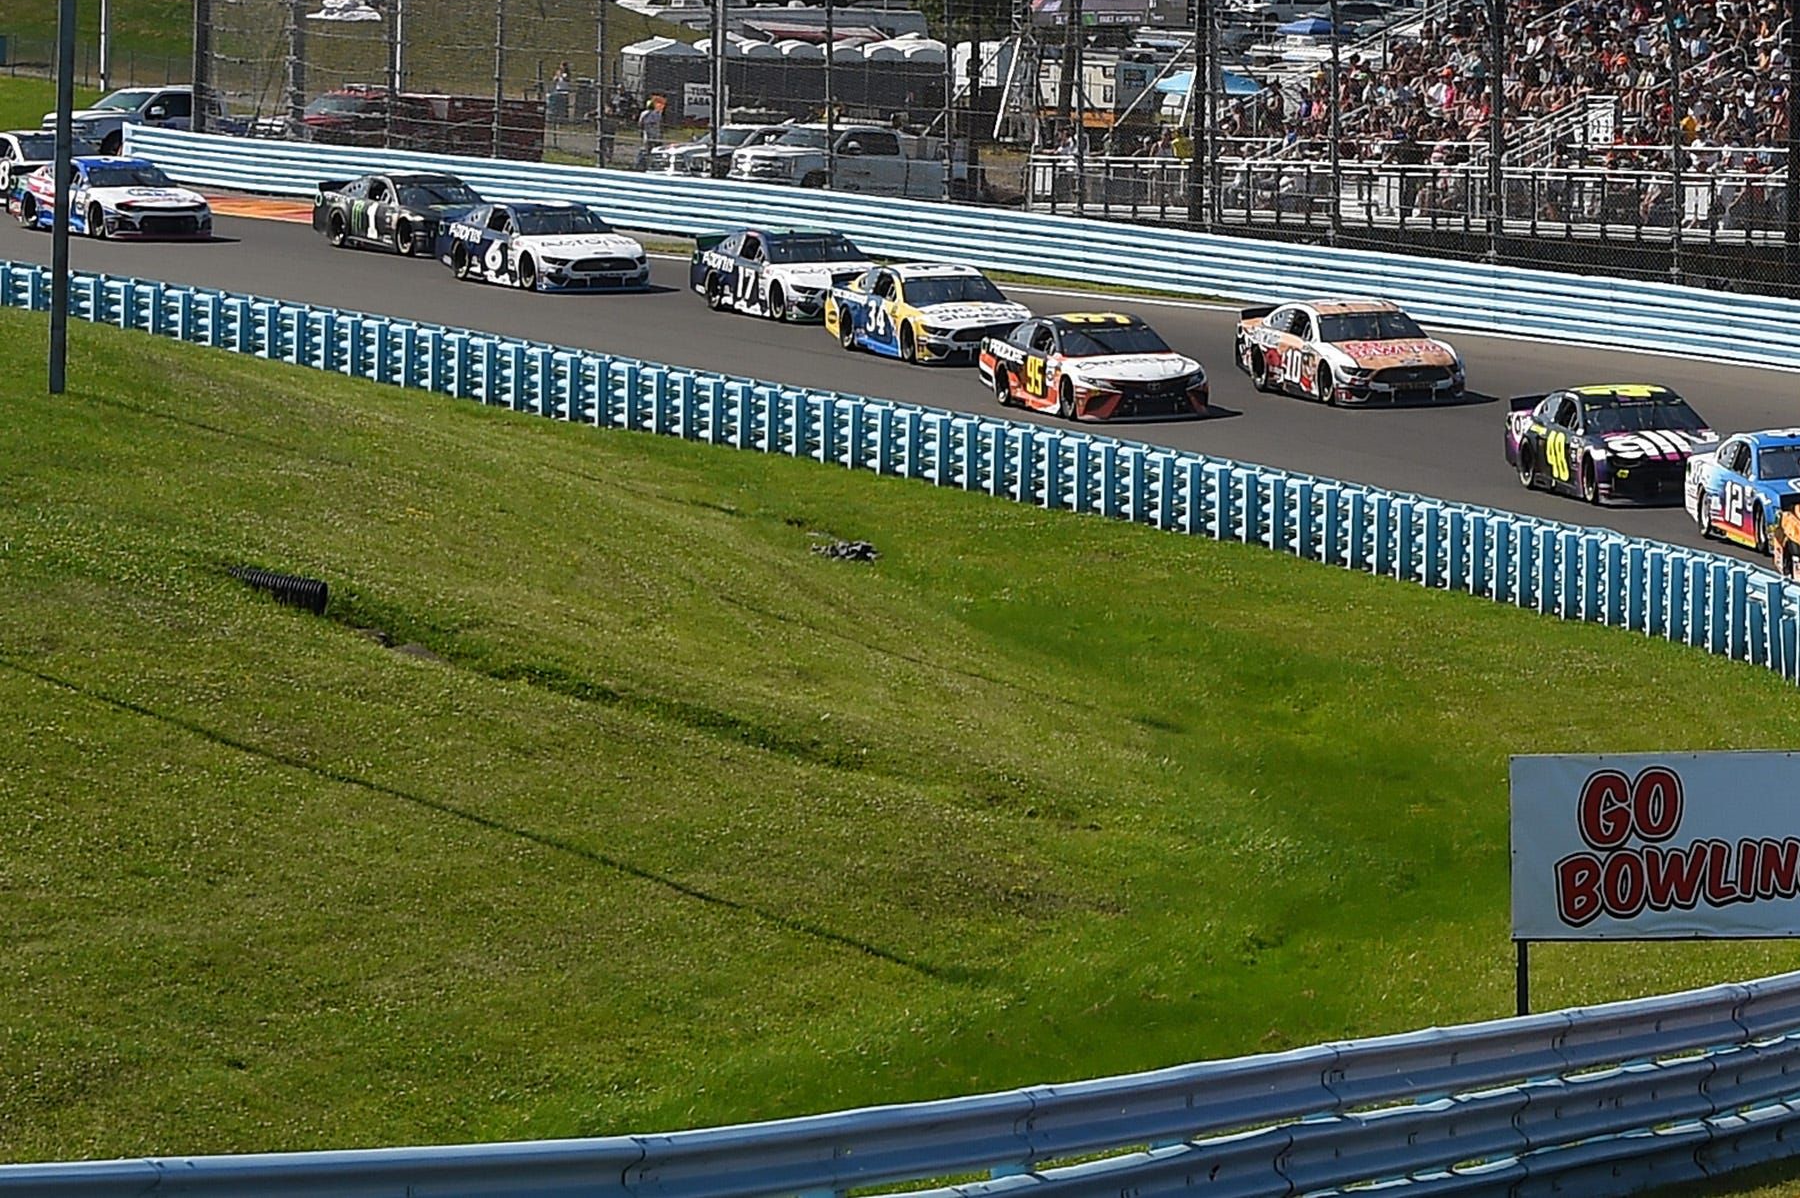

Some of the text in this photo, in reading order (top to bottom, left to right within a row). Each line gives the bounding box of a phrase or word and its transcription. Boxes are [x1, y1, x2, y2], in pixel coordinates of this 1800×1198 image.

[366, 202, 379, 240] 1
[484, 239, 506, 272] 6
[736, 265, 756, 301] 17
[865, 300, 885, 335] 34
[1025, 354, 1046, 397] 95
[1283, 348, 1302, 384] 10
[1546, 430, 1570, 482] 48
[1724, 480, 1744, 527] 12
[1576, 764, 1684, 852] GO
